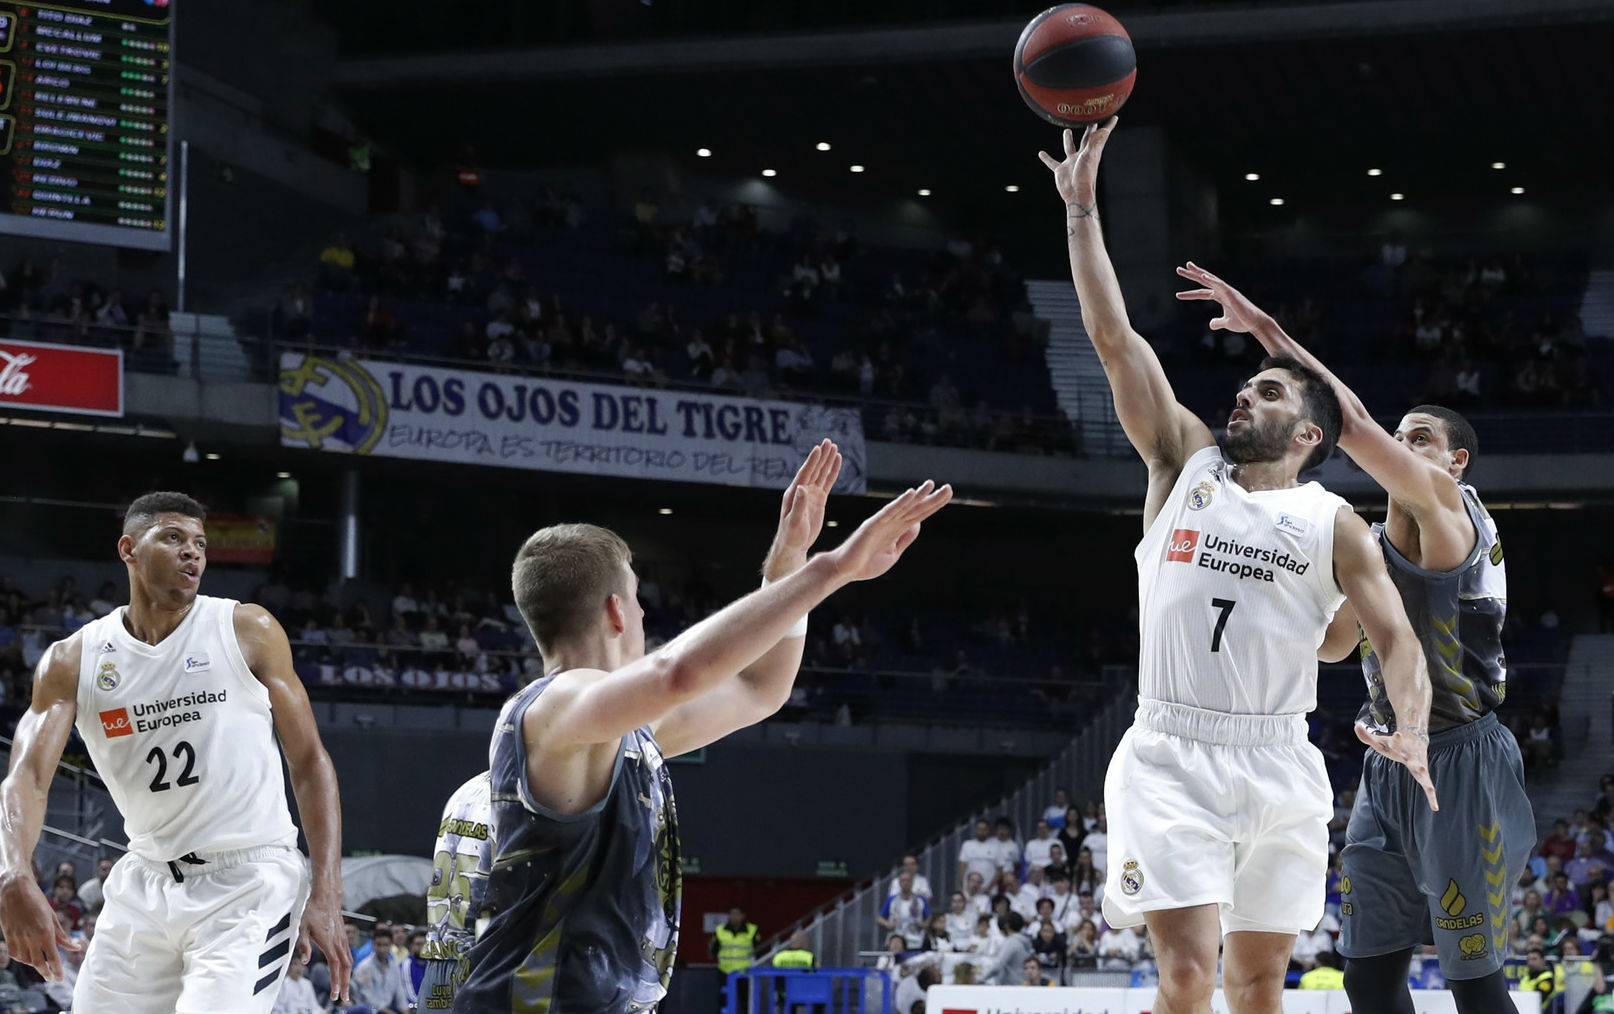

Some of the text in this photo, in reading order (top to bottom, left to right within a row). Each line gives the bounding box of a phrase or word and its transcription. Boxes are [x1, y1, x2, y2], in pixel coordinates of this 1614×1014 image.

[388, 371, 792, 445] LOS OJOS DEL TIGRE
[389, 425, 494, 457] EUROPA
[500, 435, 535, 460] ES
[539, 439, 686, 470] TERRITORIO
[692, 452, 745, 475] DEL
[1198, 552, 1274, 582] Europea
[1204, 534, 1310, 576] Universidad
[1211, 597, 1236, 652] 7
[319, 664, 500, 689] LOS OJOS
[133, 690, 227, 716] Universidad
[137, 711, 201, 733] Europea
[146, 740, 199, 792] 22
[1434, 912, 1484, 931] CANDELAS
